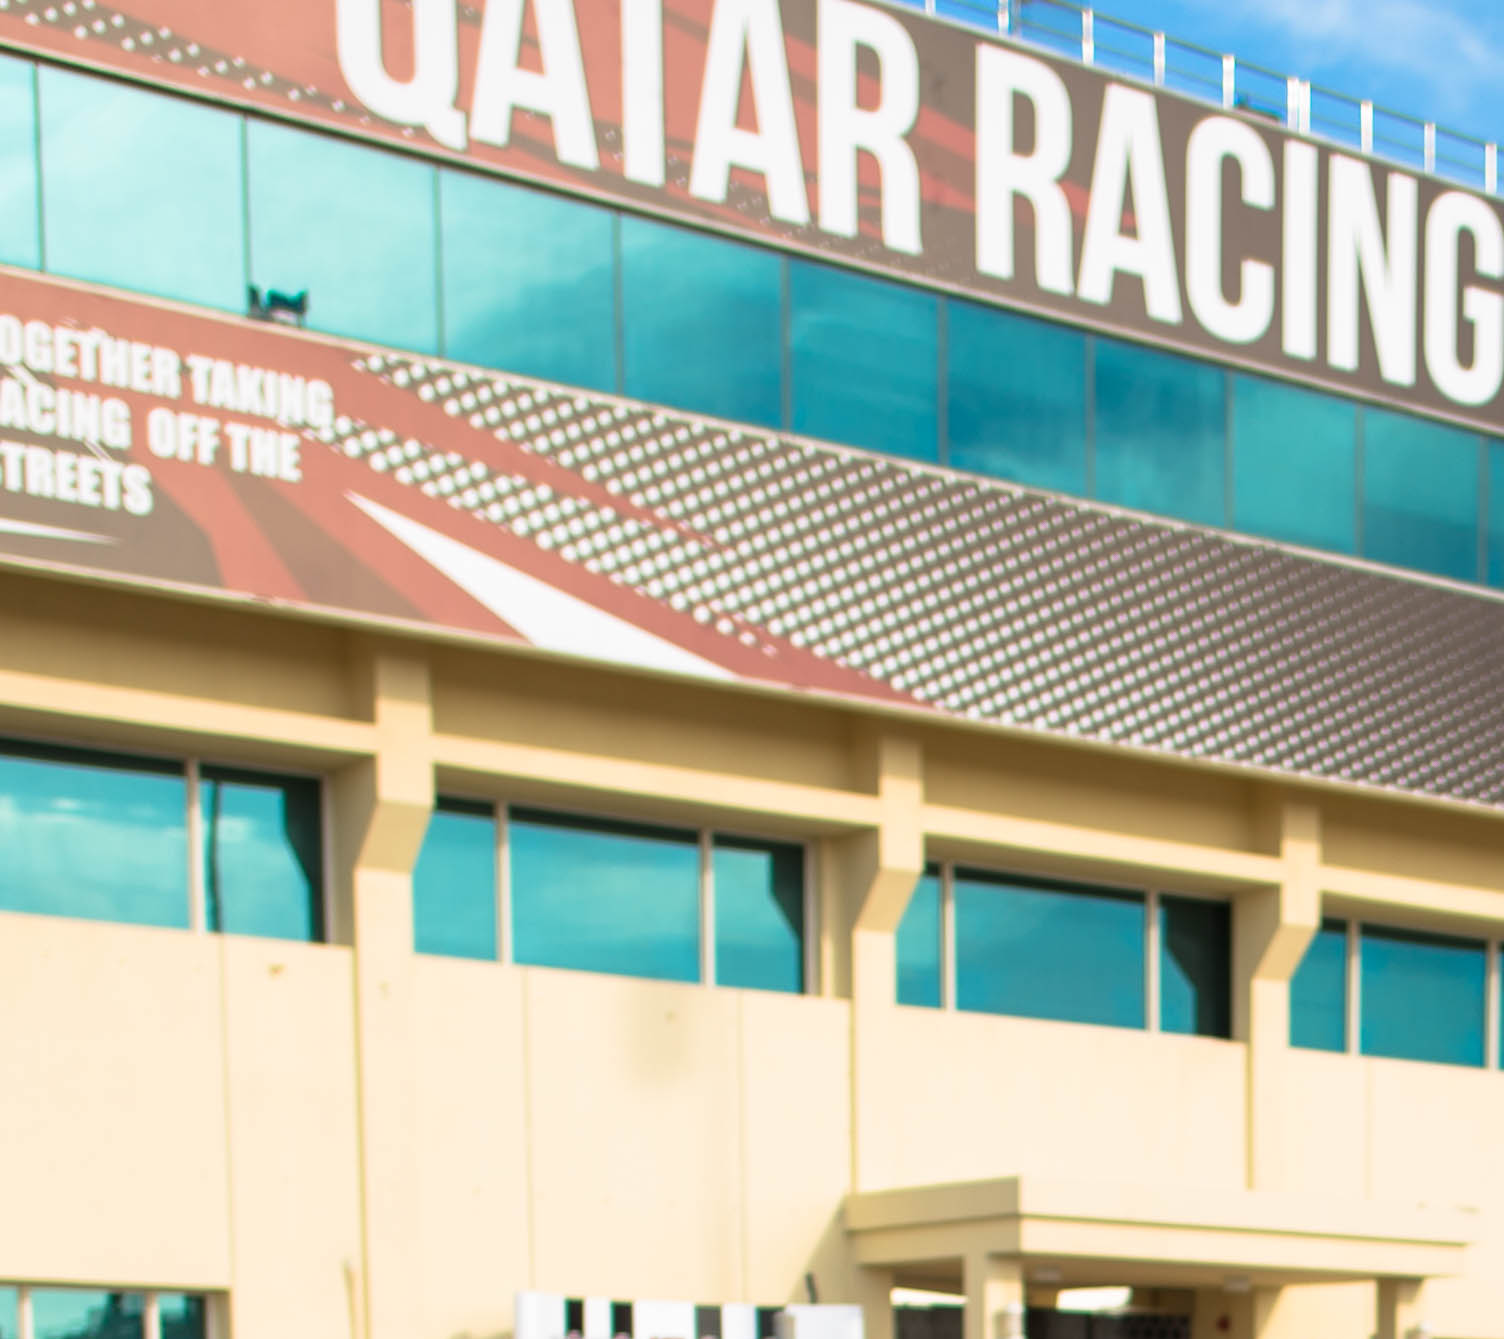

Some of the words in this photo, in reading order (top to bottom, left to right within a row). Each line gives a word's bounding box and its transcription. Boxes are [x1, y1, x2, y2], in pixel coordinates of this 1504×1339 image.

[336, 0, 923, 255] QATAR
[189, 352, 336, 432] TAKING
[147, 405, 223, 466] OFF
[226, 420, 304, 484] THE
